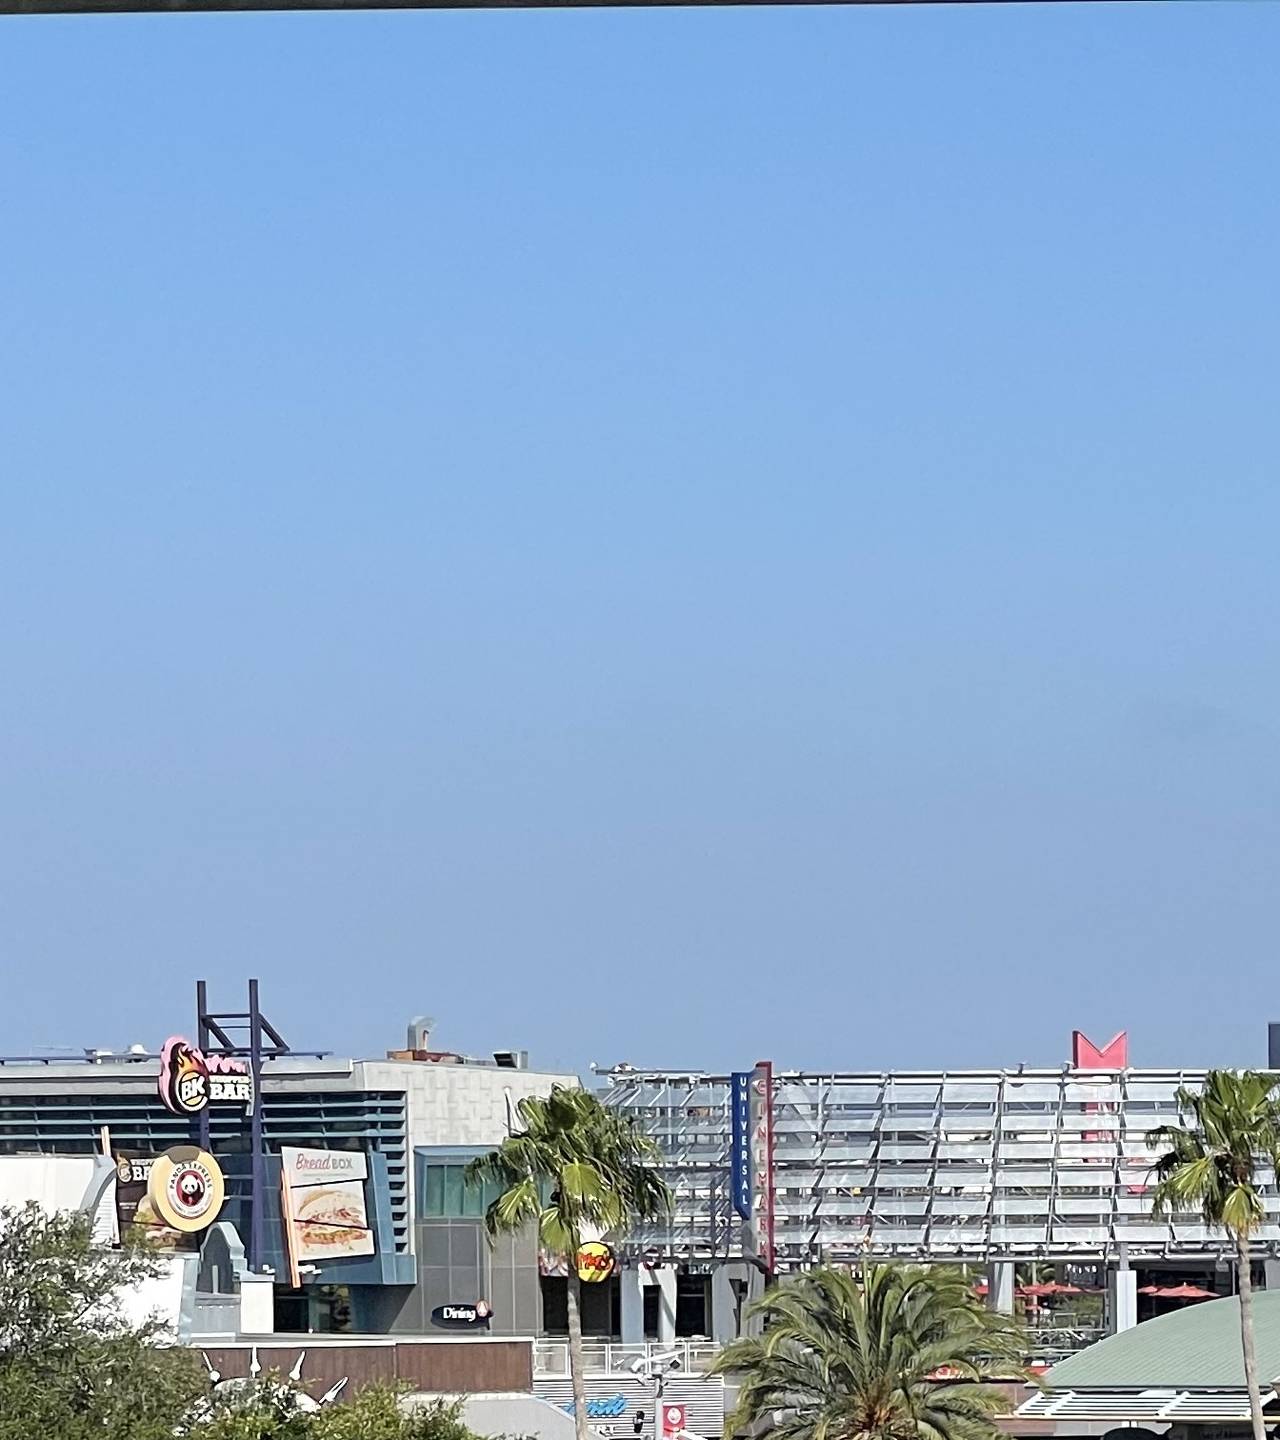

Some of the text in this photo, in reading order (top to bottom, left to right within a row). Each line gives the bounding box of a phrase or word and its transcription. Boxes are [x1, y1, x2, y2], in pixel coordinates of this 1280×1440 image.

[181, 1075, 205, 1101] BK
[209, 1083, 250, 1100] BAR
[739, 1077, 749, 1205] UNIVERSAL
[295, 1153, 353, 1170] Bread BOX
[757, 1079, 768, 1259] CINEMARK
[443, 1307, 477, 1322] Dining
